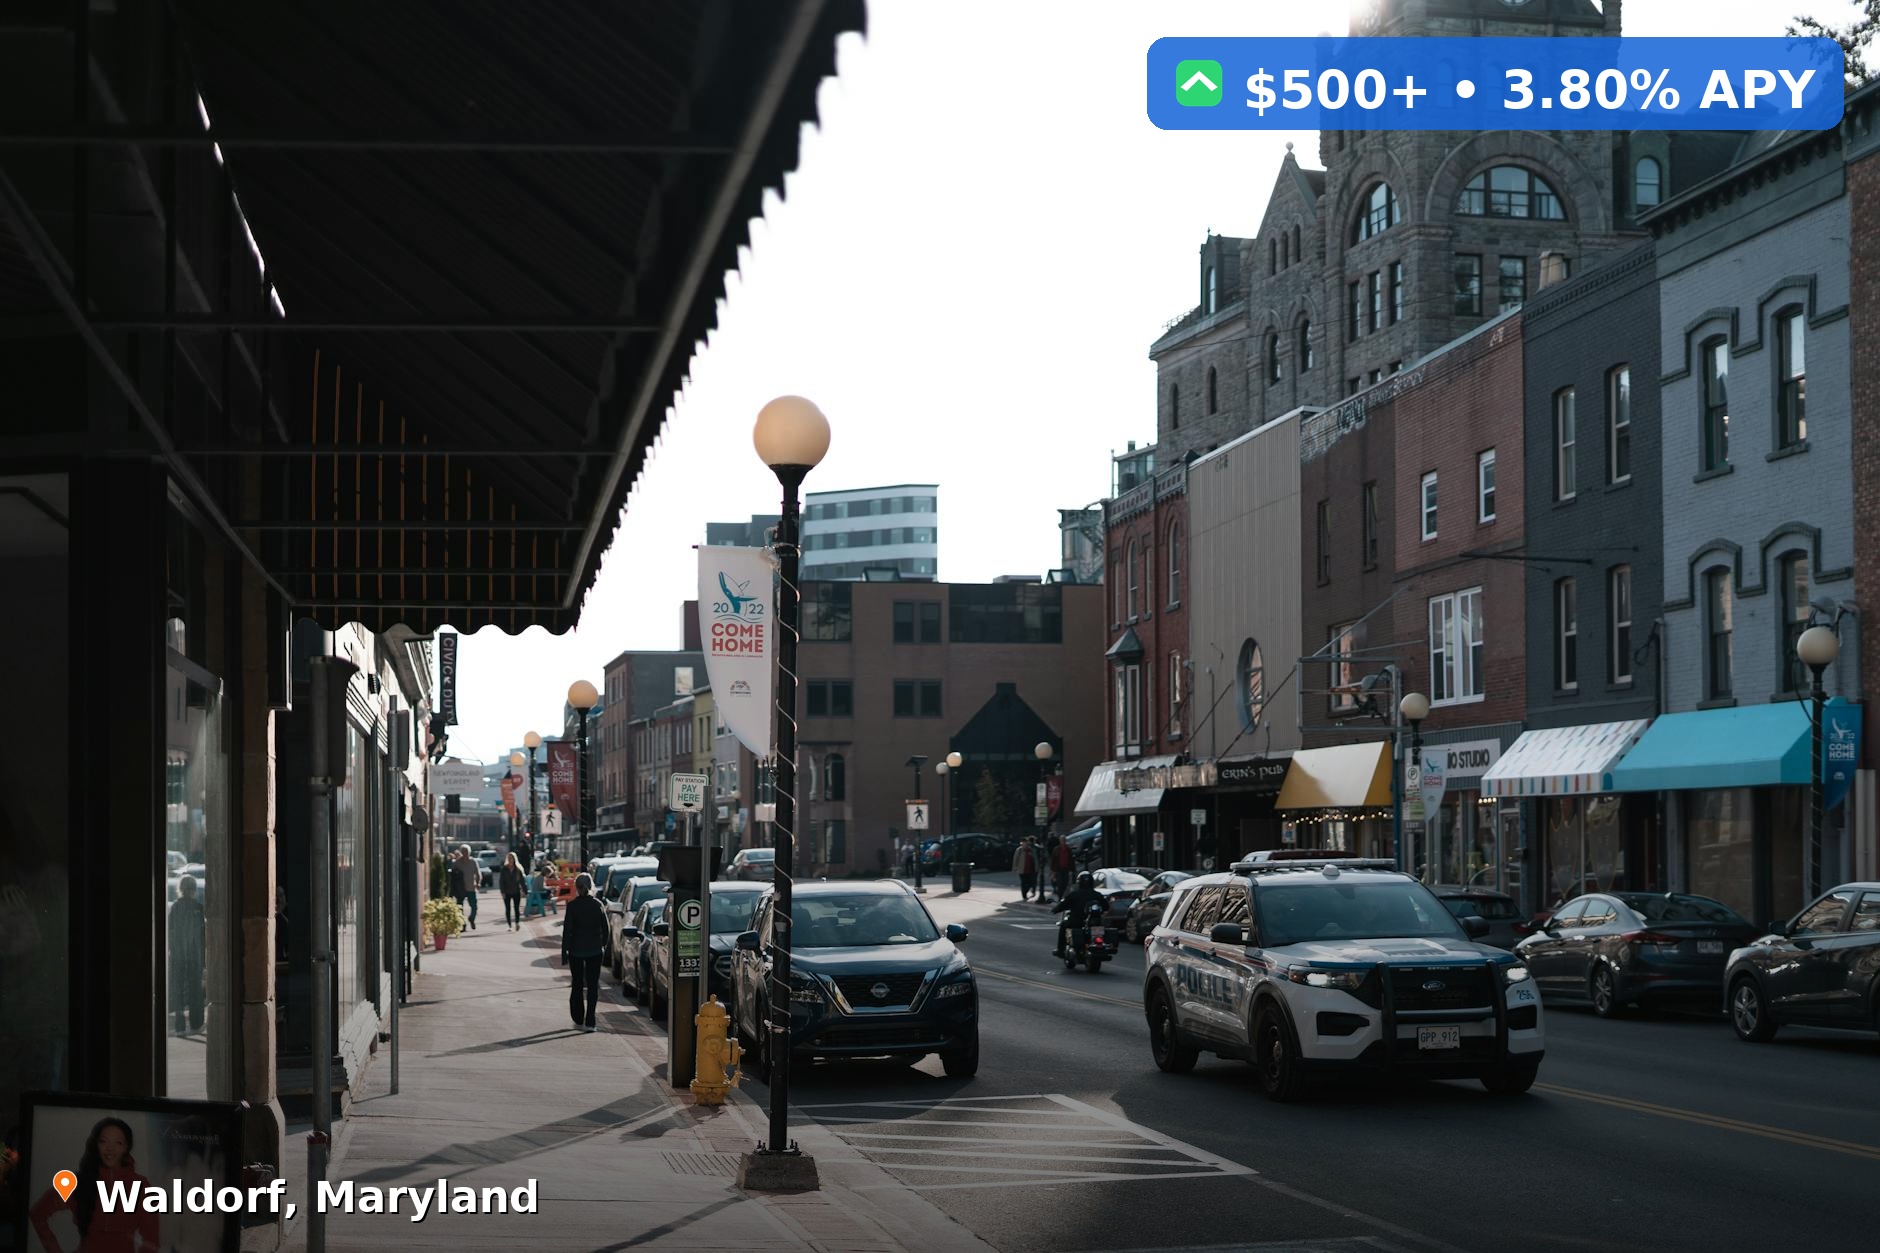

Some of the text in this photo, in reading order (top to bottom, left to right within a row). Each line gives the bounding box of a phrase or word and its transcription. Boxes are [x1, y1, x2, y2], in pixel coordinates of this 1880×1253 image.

[713, 602, 765, 615] 20 22
[711, 622, 765, 638] COME
[711, 637, 765, 653] HOME
[1828, 743, 1856, 751] COME
[1459, 749, 1490, 769] STUDIO
[1828, 751, 1856, 759] HOME
[681, 784, 697, 793] PAY
[677, 793, 701, 802] HERE
[687, 906, 700, 924] P
[1177, 964, 1234, 1004] POLICE
[1420, 1031, 1459, 1043] GPP 912
